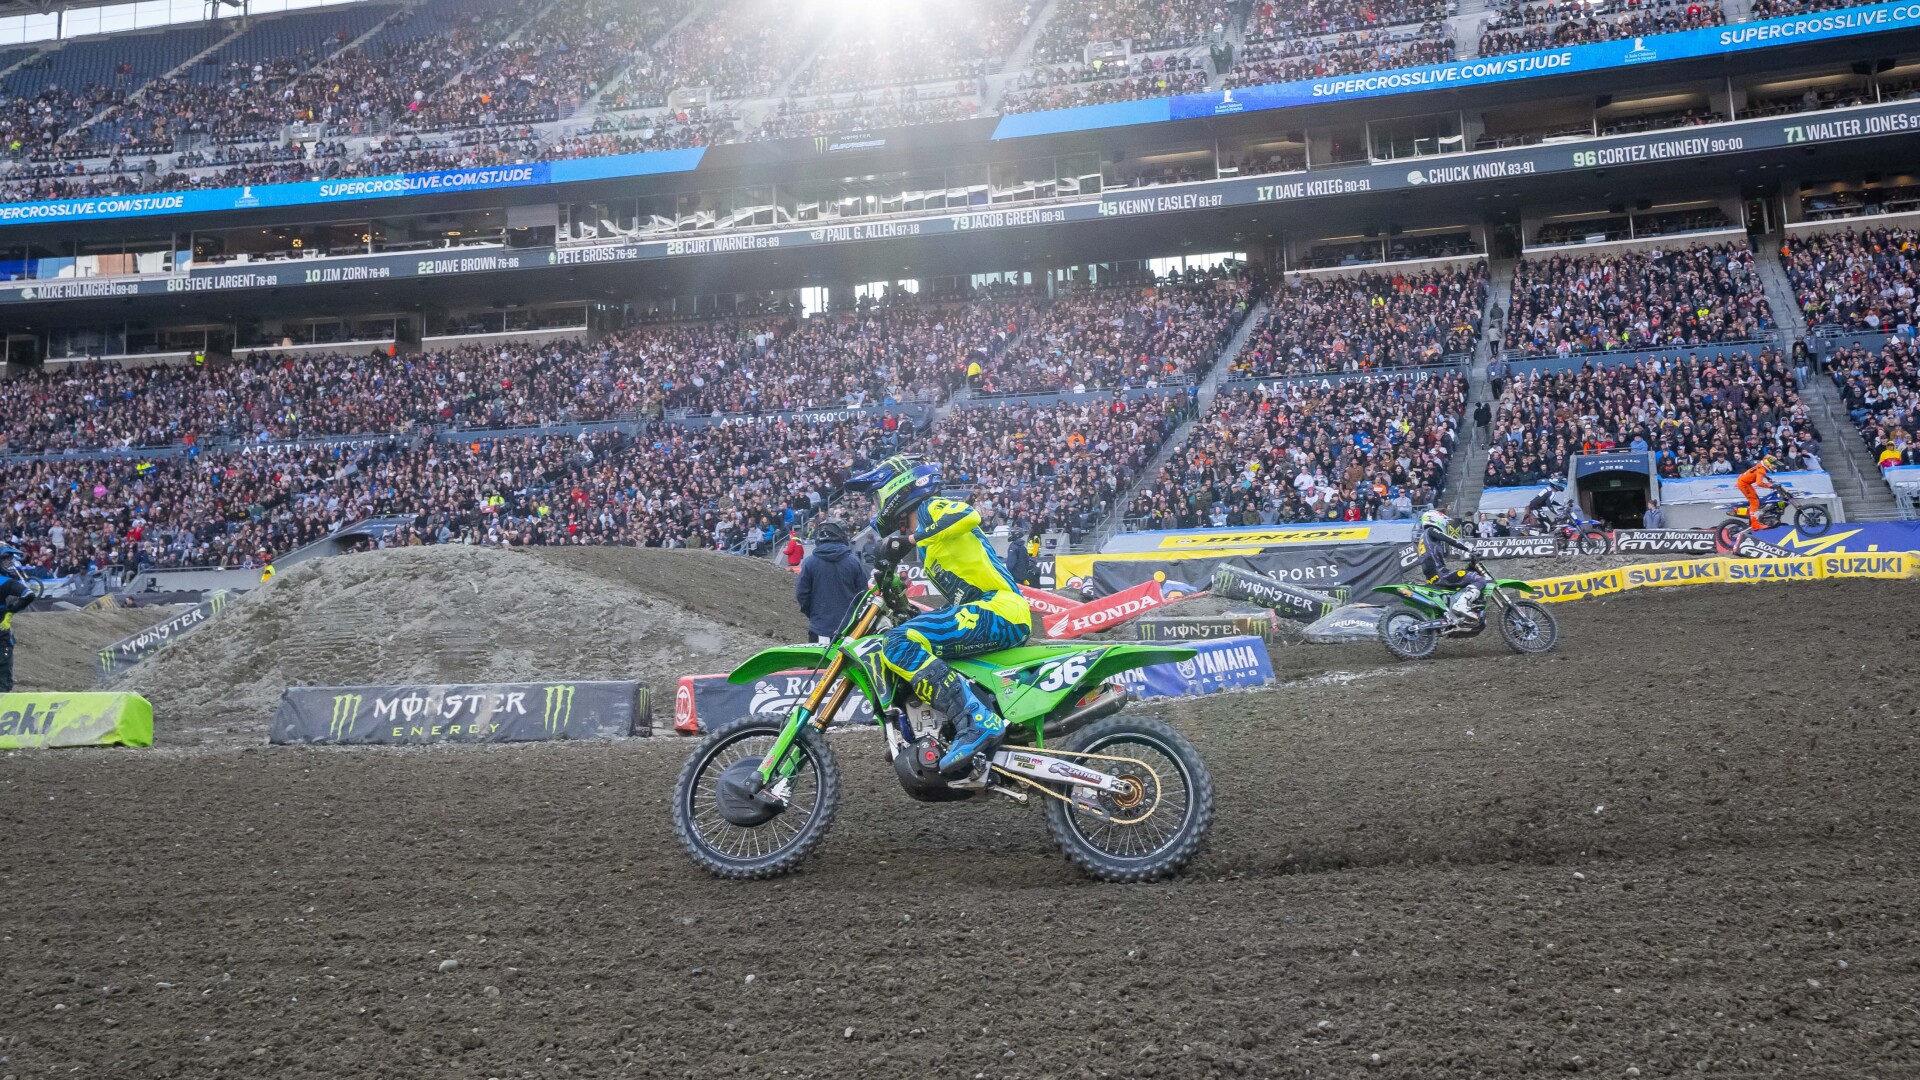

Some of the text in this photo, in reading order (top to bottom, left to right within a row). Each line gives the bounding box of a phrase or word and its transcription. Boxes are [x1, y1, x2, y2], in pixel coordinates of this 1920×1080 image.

[1312, 51, 1573, 97] SUPERCROSSLIVE.COM/STJUDE
[1783, 126, 1806, 143] 71
[1806, 119, 1861, 141] WALTER
[1864, 113, 1909, 134] JONES
[1573, 137, 1743, 168] 96 CORTEZ KENNEDY 90-00
[1429, 161, 1536, 184] CHUCK KNOX 83-91
[319, 168, 532, 198] SUPERCROSSLIVE.COM/STJUDE
[1256, 179, 1372, 201] 17 DAVE KRIEG 80-91
[1098, 194, 1223, 216] 45 KENNY EASLEY 81-87
[952, 209, 1065, 230] 79 JACOB GREEN 80-91
[826, 227, 852, 242] PAUL
[853, 226, 863, 239] G.
[865, 223, 897, 238] ALLEN
[897, 223, 920, 236] 97-18
[667, 236, 780, 255] 28 CURT WARNER 83-89
[418, 256, 519, 274] 22 DAVE BROWN 76-86
[557, 247, 637, 264] PETE GROSS 76-92
[167, 273, 277, 292] 80 STEVE LARGENT 76-89
[305, 266, 390, 283] 10 JIM ZORN 76-84
[37, 281, 138, 299] MIKE HOLMGREN 99-08
[1205, 531, 1356, 543] DUNLOP
[1476, 538, 1554, 548] ROCKY MOUNTAIN
[1632, 531, 1715, 540] ROCKY MOUNTAIN
[1756, 541, 1788, 556] ROCKY
[1268, 564, 1339, 581] SPORTS
[1629, 562, 1720, 584] SUZUKI
[1729, 561, 1813, 580] SUZUKI
[1826, 557, 1902, 574] SUZUKI
[1239, 579, 1313, 612] MONSTER
[1528, 574, 1618, 600] SUZUKI
[1071, 595, 1159, 631] HONDA
[121, 608, 205, 656] MONSTER
[1163, 623, 1242, 639] MONSTER
[1329, 619, 1373, 628] TRIUMPH
[1195, 645, 1259, 675] YAMAHA
[1038, 655, 1088, 692] 36
[1187, 669, 1258, 686] RACING
[373, 691, 528, 722] MONSTER
[392, 723, 500, 737] ENERGY
